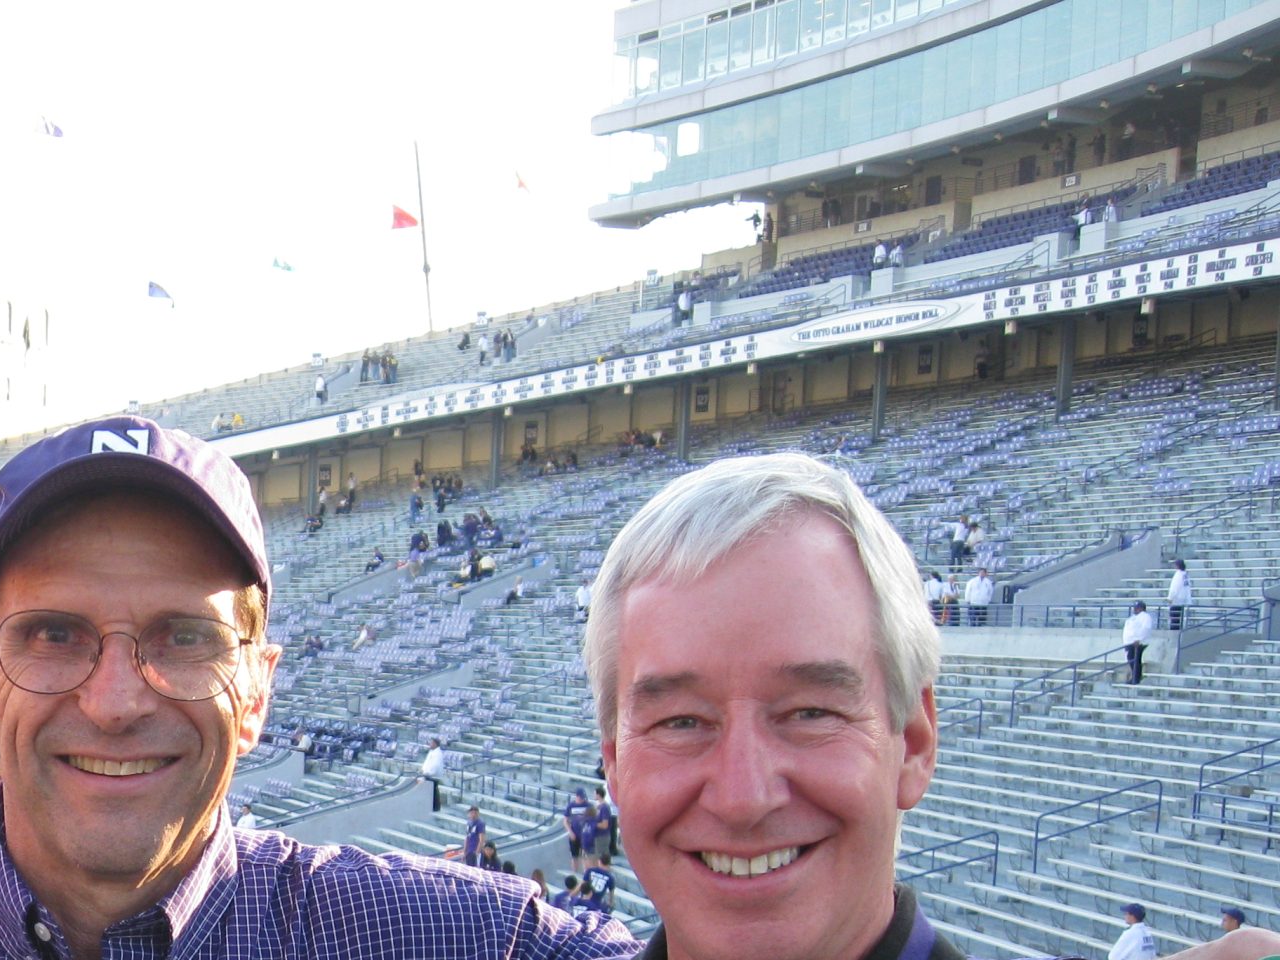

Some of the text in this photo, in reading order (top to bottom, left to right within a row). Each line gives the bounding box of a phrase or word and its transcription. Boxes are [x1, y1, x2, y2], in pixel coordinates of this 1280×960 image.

[797, 308, 939, 341] THE OTTO GRAHAM WILDCAT HONOR ROLL
